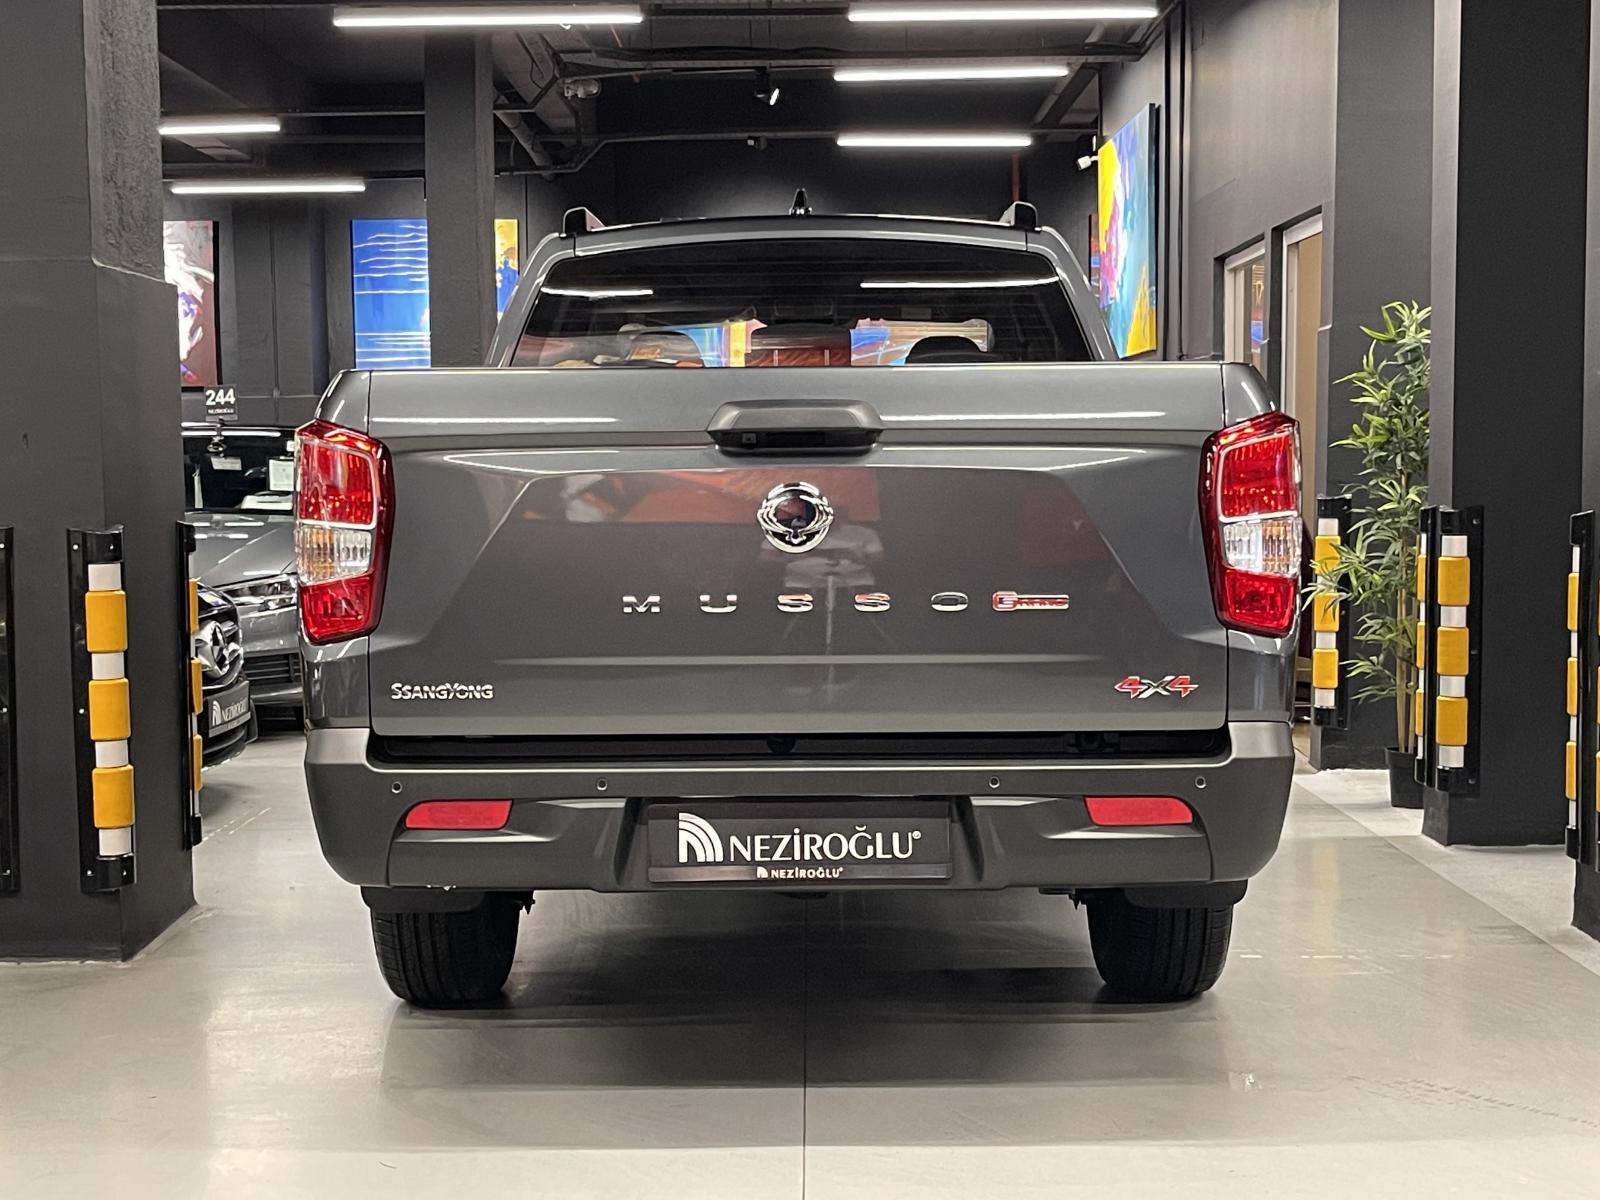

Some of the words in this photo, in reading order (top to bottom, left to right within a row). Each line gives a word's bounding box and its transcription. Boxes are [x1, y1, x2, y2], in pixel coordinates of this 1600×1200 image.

[205, 388, 236, 405] 244
[622, 592, 968, 613] MUSSO
[729, 825, 914, 862] NEZİROĞLU
